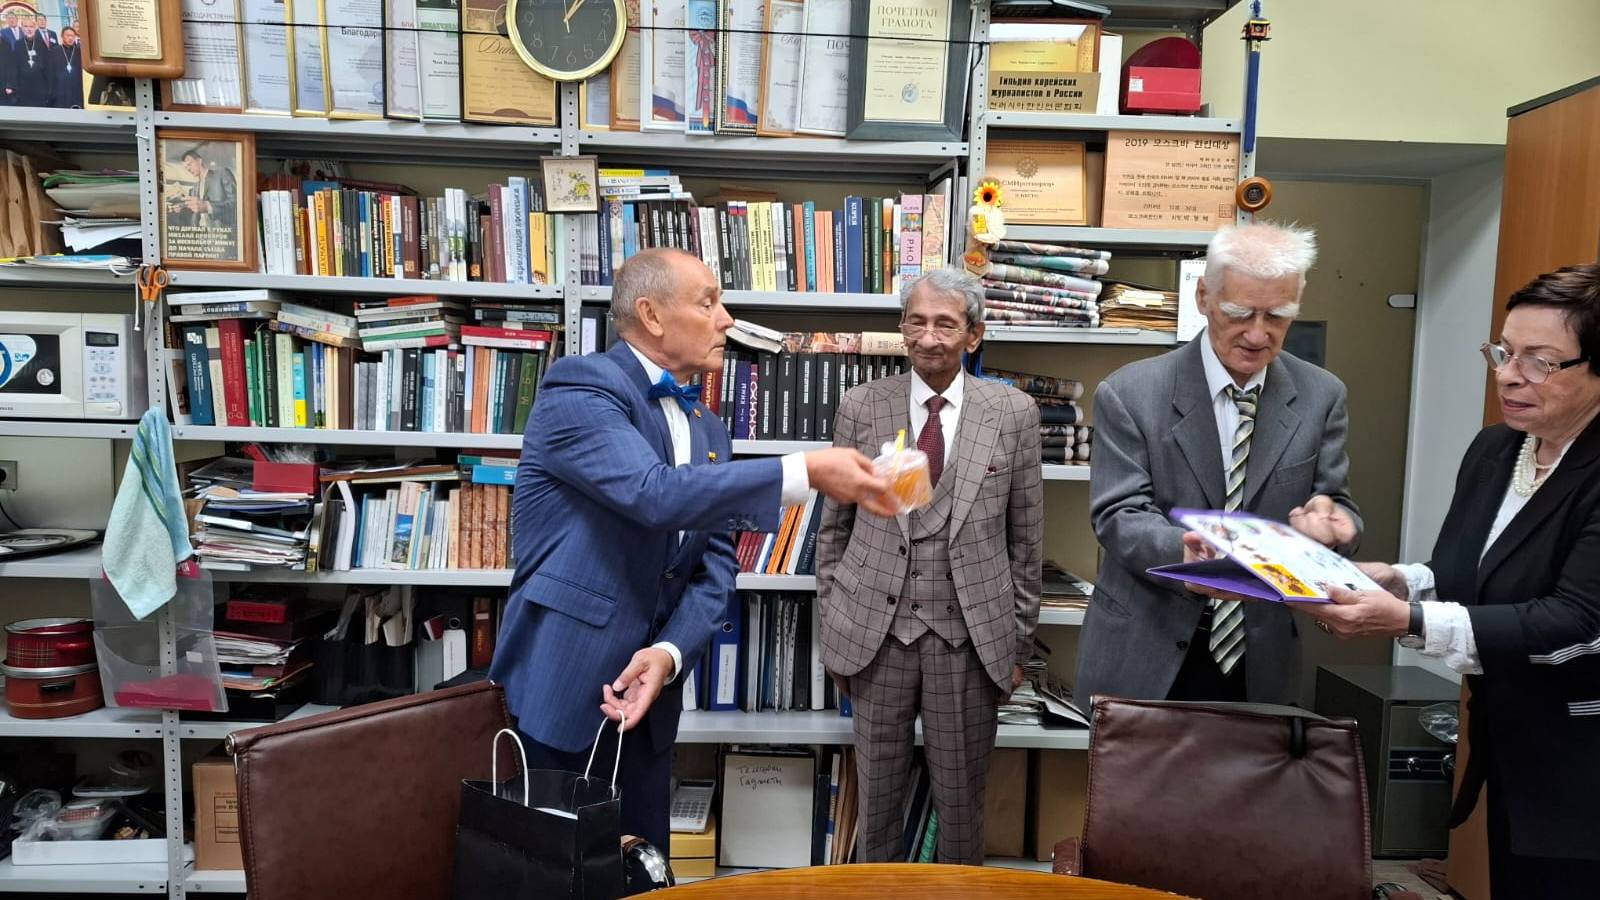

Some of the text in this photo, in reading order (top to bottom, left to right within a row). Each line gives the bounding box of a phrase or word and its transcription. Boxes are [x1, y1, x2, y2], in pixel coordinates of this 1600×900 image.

[881, 18, 933, 29] ГРАМОТА
[551, 45, 561, 62] 7
[583, 43, 595, 60] 5
[566, 50, 577, 66] 6
[999, 76, 1077, 88] Гильдия корейских
[991, 88, 1043, 99] журналистов
[1053, 88, 1083, 98] России
[1125, 138, 1149, 148] 2019
[1152, 138, 1190, 149] 모스크바
